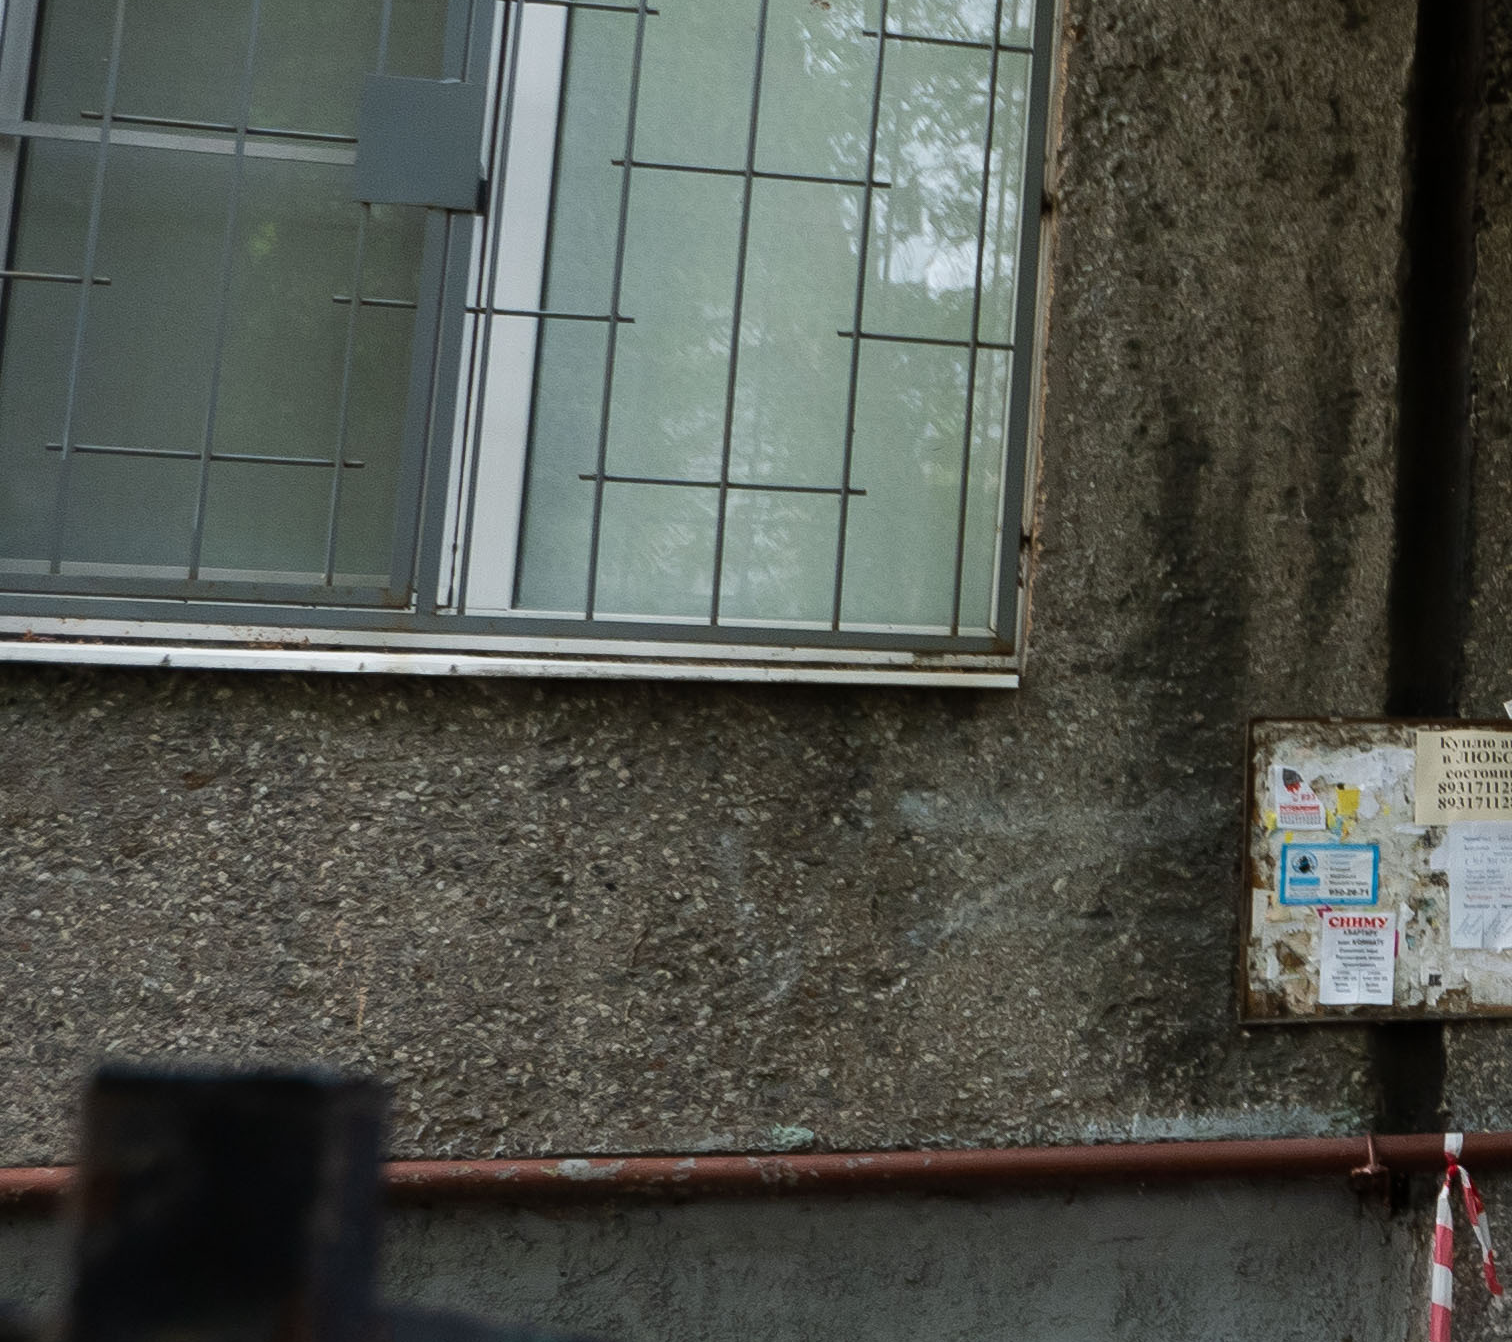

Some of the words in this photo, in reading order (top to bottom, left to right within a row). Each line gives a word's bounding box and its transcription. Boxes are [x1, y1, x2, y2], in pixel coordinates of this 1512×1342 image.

[1440, 737, 1496, 752] Куплю
[1443, 755, 1451, 764] в
[1328, 917, 1388, 928] СНИМУ
